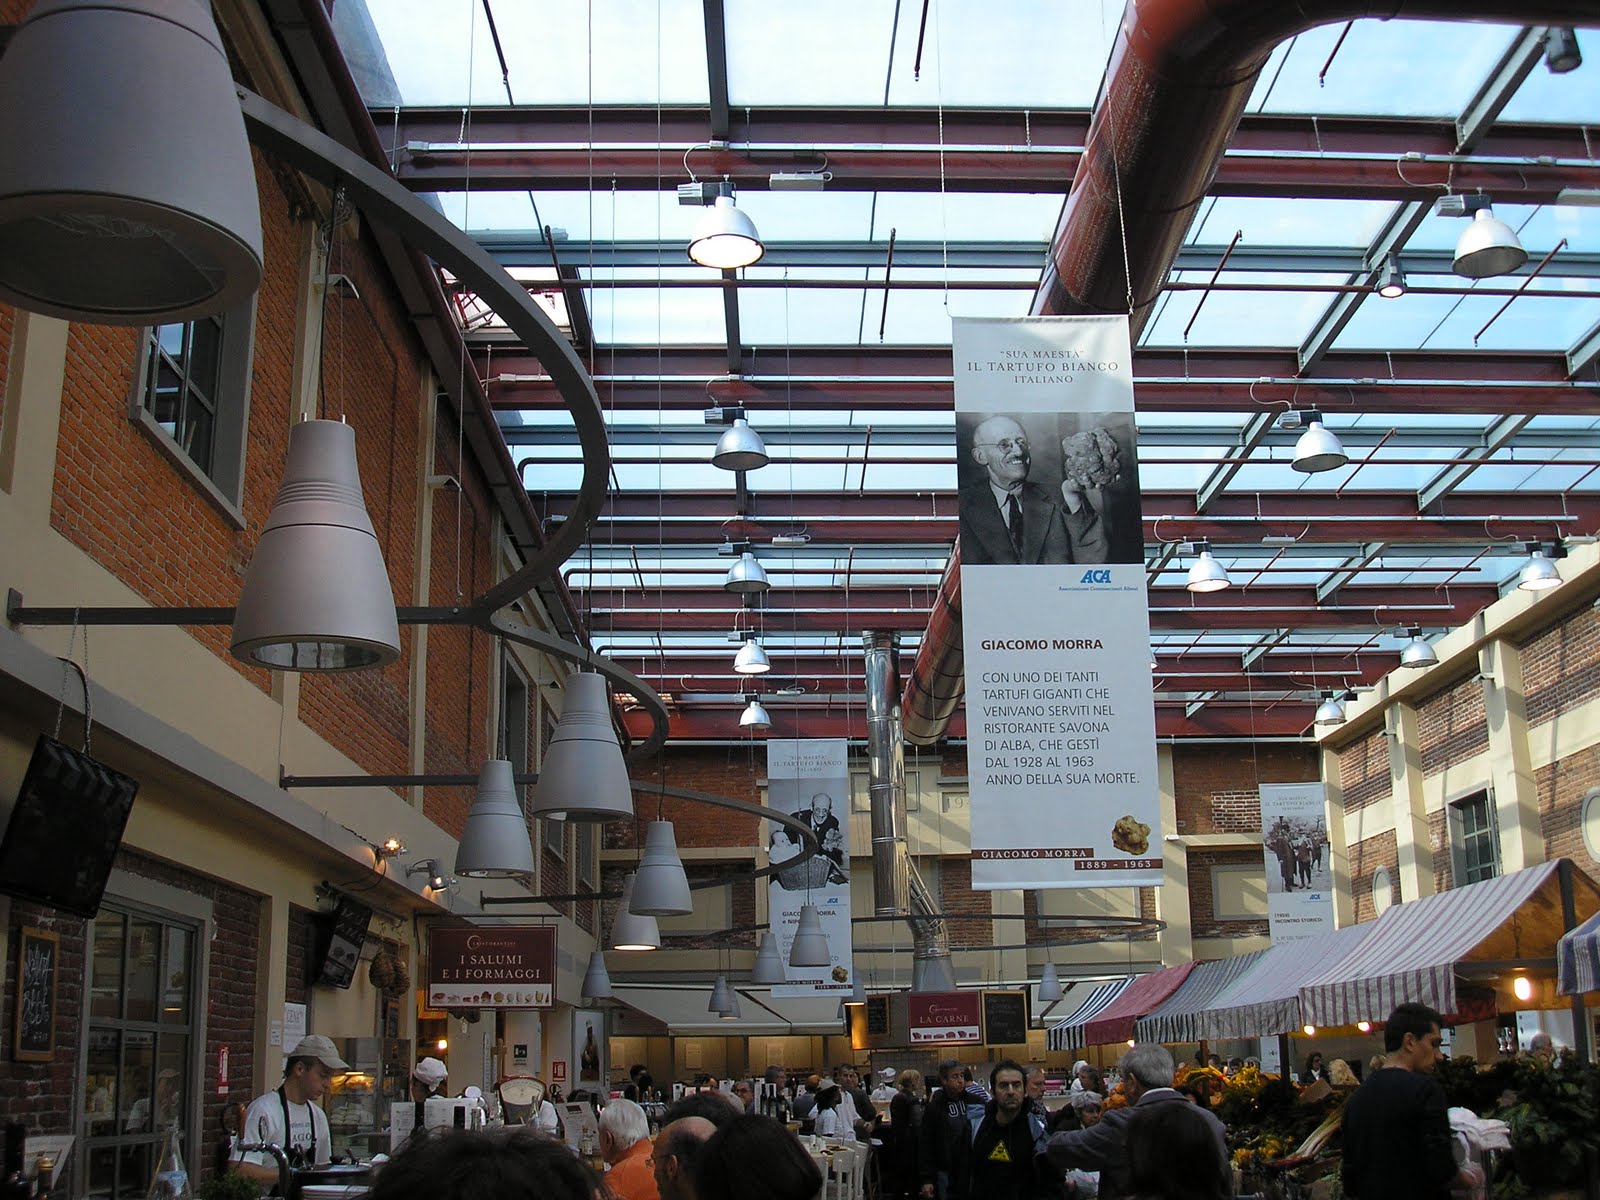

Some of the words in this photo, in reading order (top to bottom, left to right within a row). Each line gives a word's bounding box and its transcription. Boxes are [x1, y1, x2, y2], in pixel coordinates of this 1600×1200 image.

[967, 361, 982, 372] IL
[986, 361, 1056, 372] TARTUFO
[1061, 361, 1119, 372] BIANCO
[1014, 375, 1074, 384] ITALIANO
[1080, 569, 1112, 584] ACA
[981, 639, 1048, 650] GIACOMO
[1052, 639, 1103, 650] MORRA
[982, 672, 1010, 683] CON
[1013, 671, 1040, 683] UNO
[1044, 671, 1062, 683] DEI
[1065, 671, 1099, 682] TANTI
[982, 689, 1029, 700] TARTUFI
[1033, 688, 1083, 699] GIGANTI
[1085, 688, 1110, 699] CHE
[983, 705, 1045, 717] VENIVANO
[1048, 705, 1090, 717] SERVITI
[1093, 705, 1115, 716] NEL
[984, 722, 1056, 734] RISTORANTE
[1059, 721, 1110, 733] SAVONA
[984, 740, 997, 751] DI
[1000, 739, 1035, 752] ALBA,
[1038, 739, 1063, 751] CHE
[1066, 737, 1100, 750] GESTÌ
[985, 757, 1009, 768] DAL
[1014, 756, 1043, 768] 1928
[1046, 756, 1061, 767] AL
[1066, 756, 1094, 767] 1963
[985, 774, 1022, 785] ANNO
[1026, 773, 1062, 785] DELLA
[1066, 773, 1091, 784] SUA
[1094, 772, 1140, 784] MORTE.
[981, 850, 1040, 859] GIACOMO
[1044, 849, 1087, 858] MORRA
[1079, 860, 1107, 869] 1889
[1123, 860, 1152, 869] 1963
[460, 955, 464, 965] I
[470, 954, 523, 965] SALUMI
[442, 969, 450, 979] E
[455, 969, 459, 979] I
[465, 968, 541, 979] FORMAGGI
[919, 1016, 932, 1024] LA
[935, 1015, 969, 1023] CARNE
